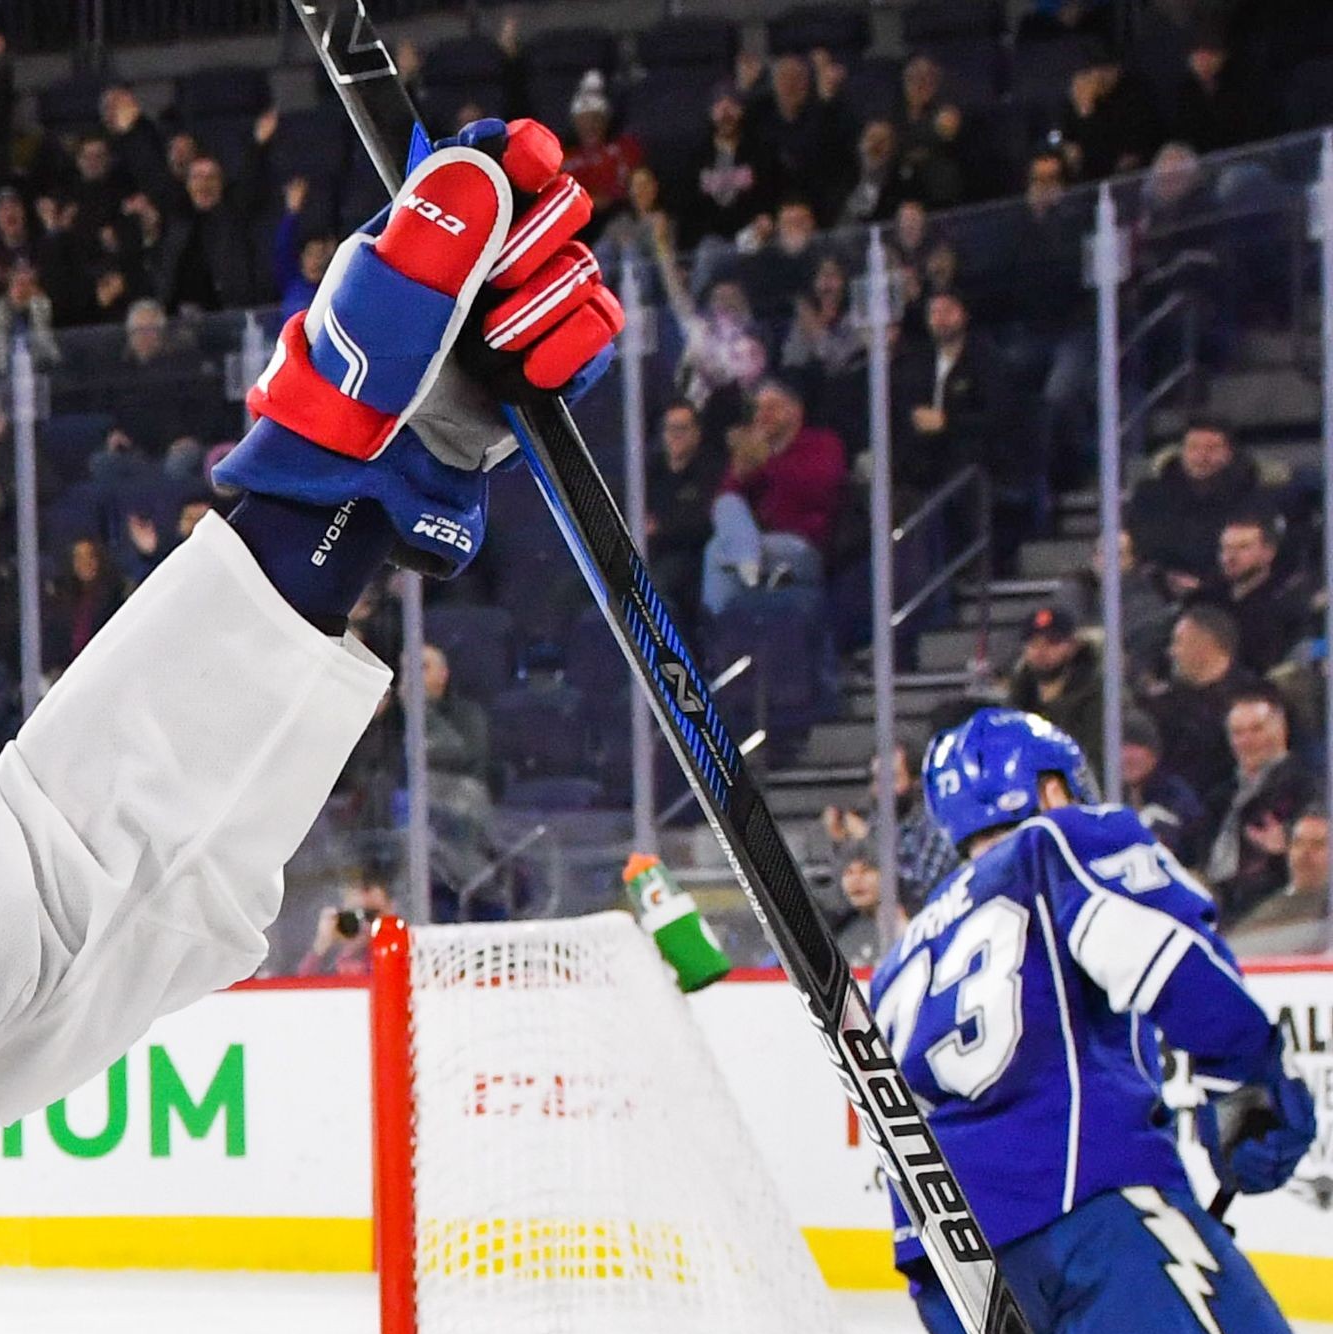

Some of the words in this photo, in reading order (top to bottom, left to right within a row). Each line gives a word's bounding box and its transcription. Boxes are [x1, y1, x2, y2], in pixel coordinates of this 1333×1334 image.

[412, 520, 474, 554] CCM
[708, 818, 768, 924] CRACKNELL
[873, 895, 1031, 1101] 73
[840, 1027, 995, 1263] BAUER
